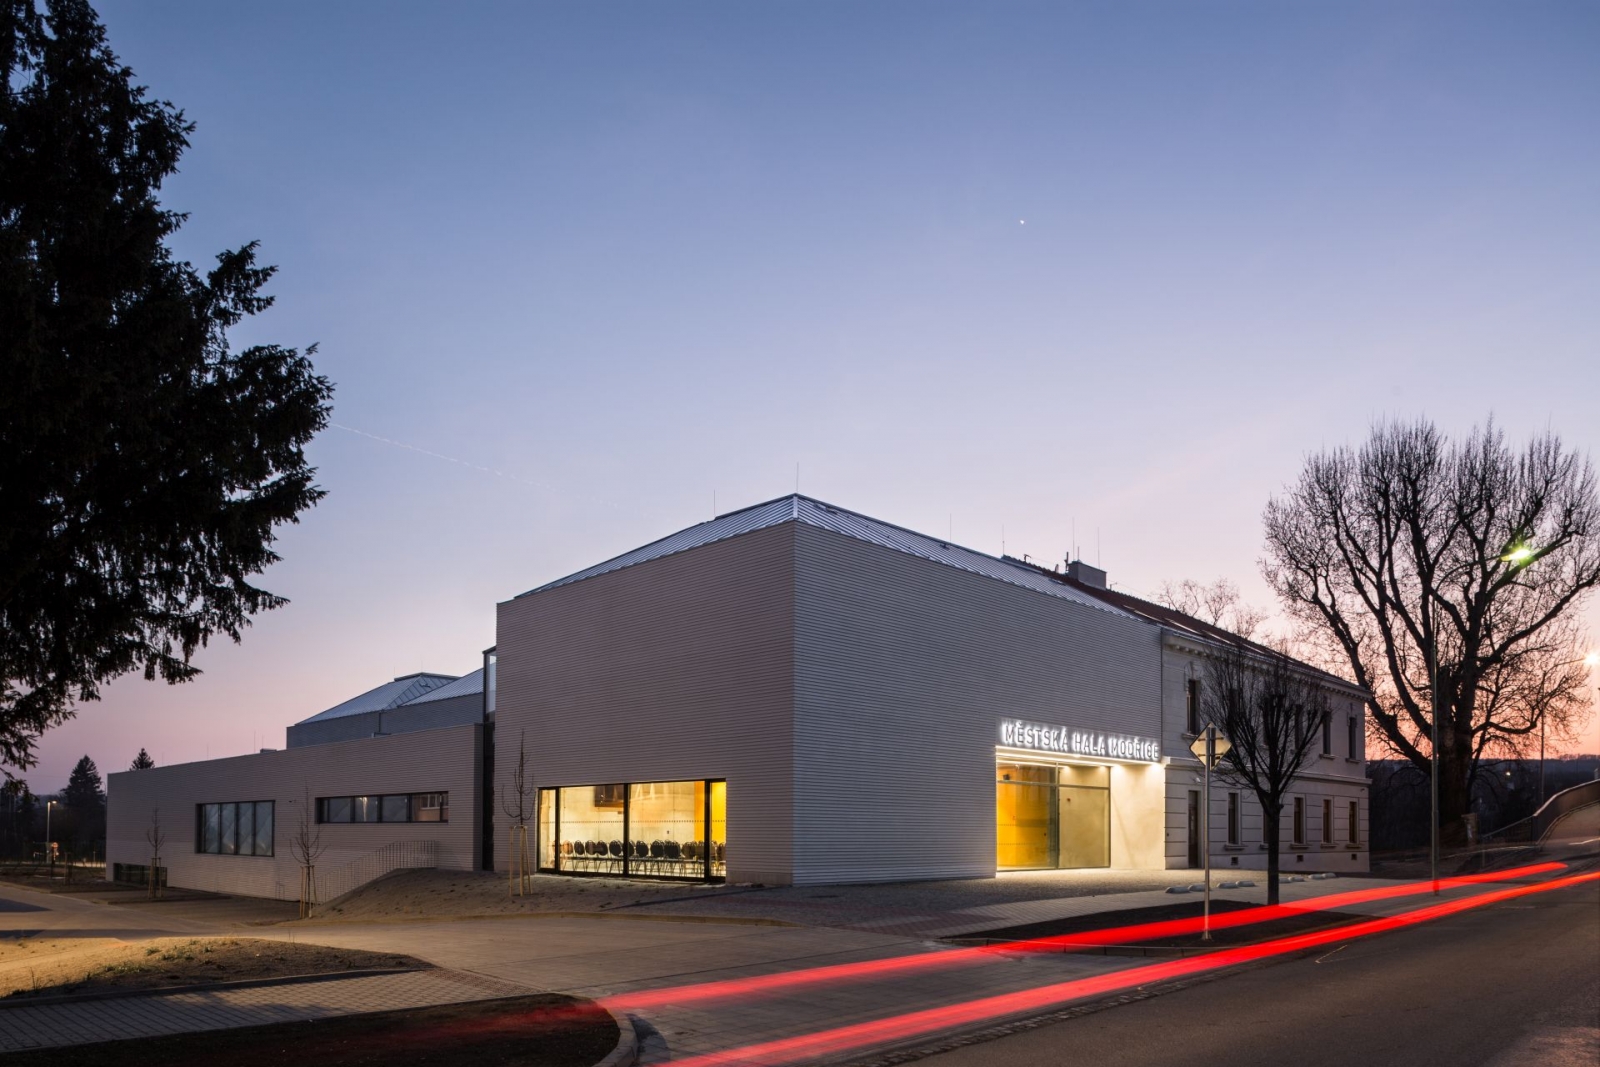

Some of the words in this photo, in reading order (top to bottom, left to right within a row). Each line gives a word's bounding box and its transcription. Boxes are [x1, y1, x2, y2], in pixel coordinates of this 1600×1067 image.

[1002, 722, 1068, 751] MĚSTSKÁ
[1072, 732, 1105, 755] HALA
[1108, 737, 1159, 760] MODŘICE
